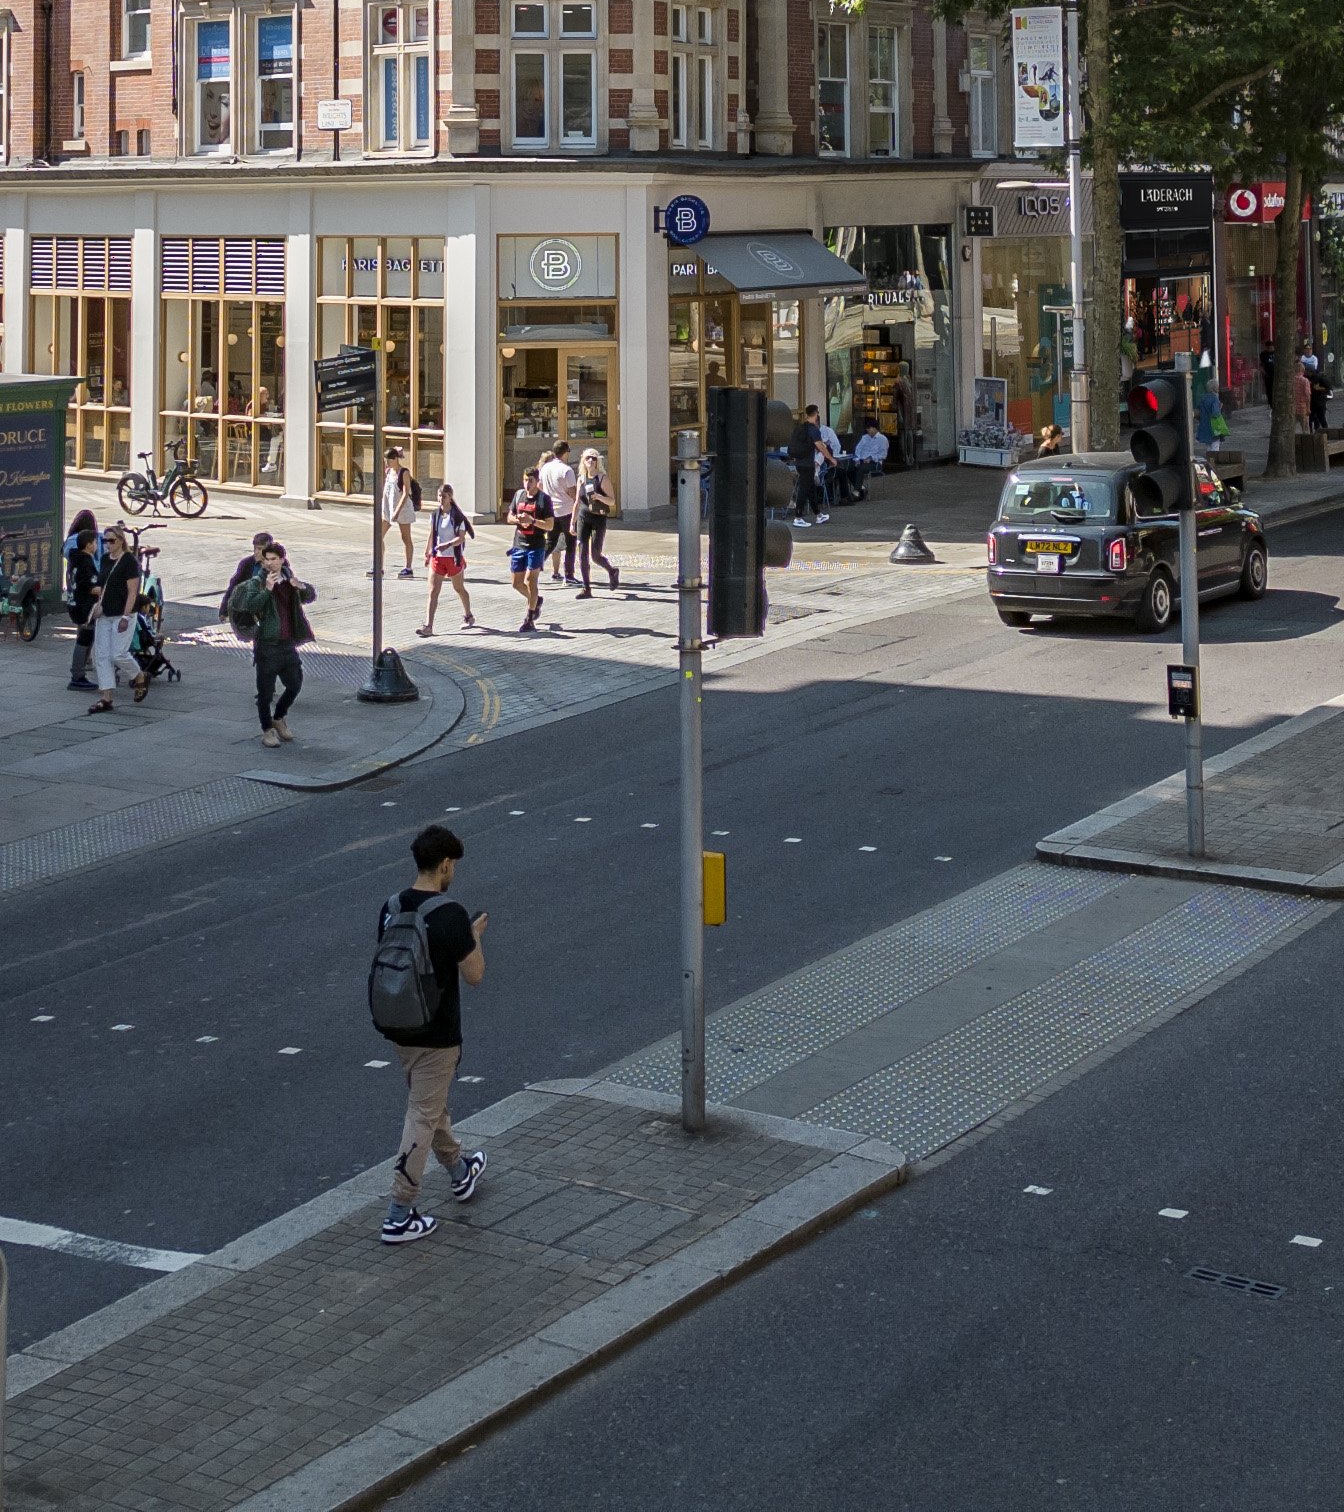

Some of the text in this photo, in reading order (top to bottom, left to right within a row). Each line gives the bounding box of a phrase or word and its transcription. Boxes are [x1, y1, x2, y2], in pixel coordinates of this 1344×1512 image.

[1019, 195, 1061, 218] IQOS
[386, 259, 444, 272] BAGETT
[672, 264, 697, 275] PARI
[6, 399, 54, 412] FLOWERS
